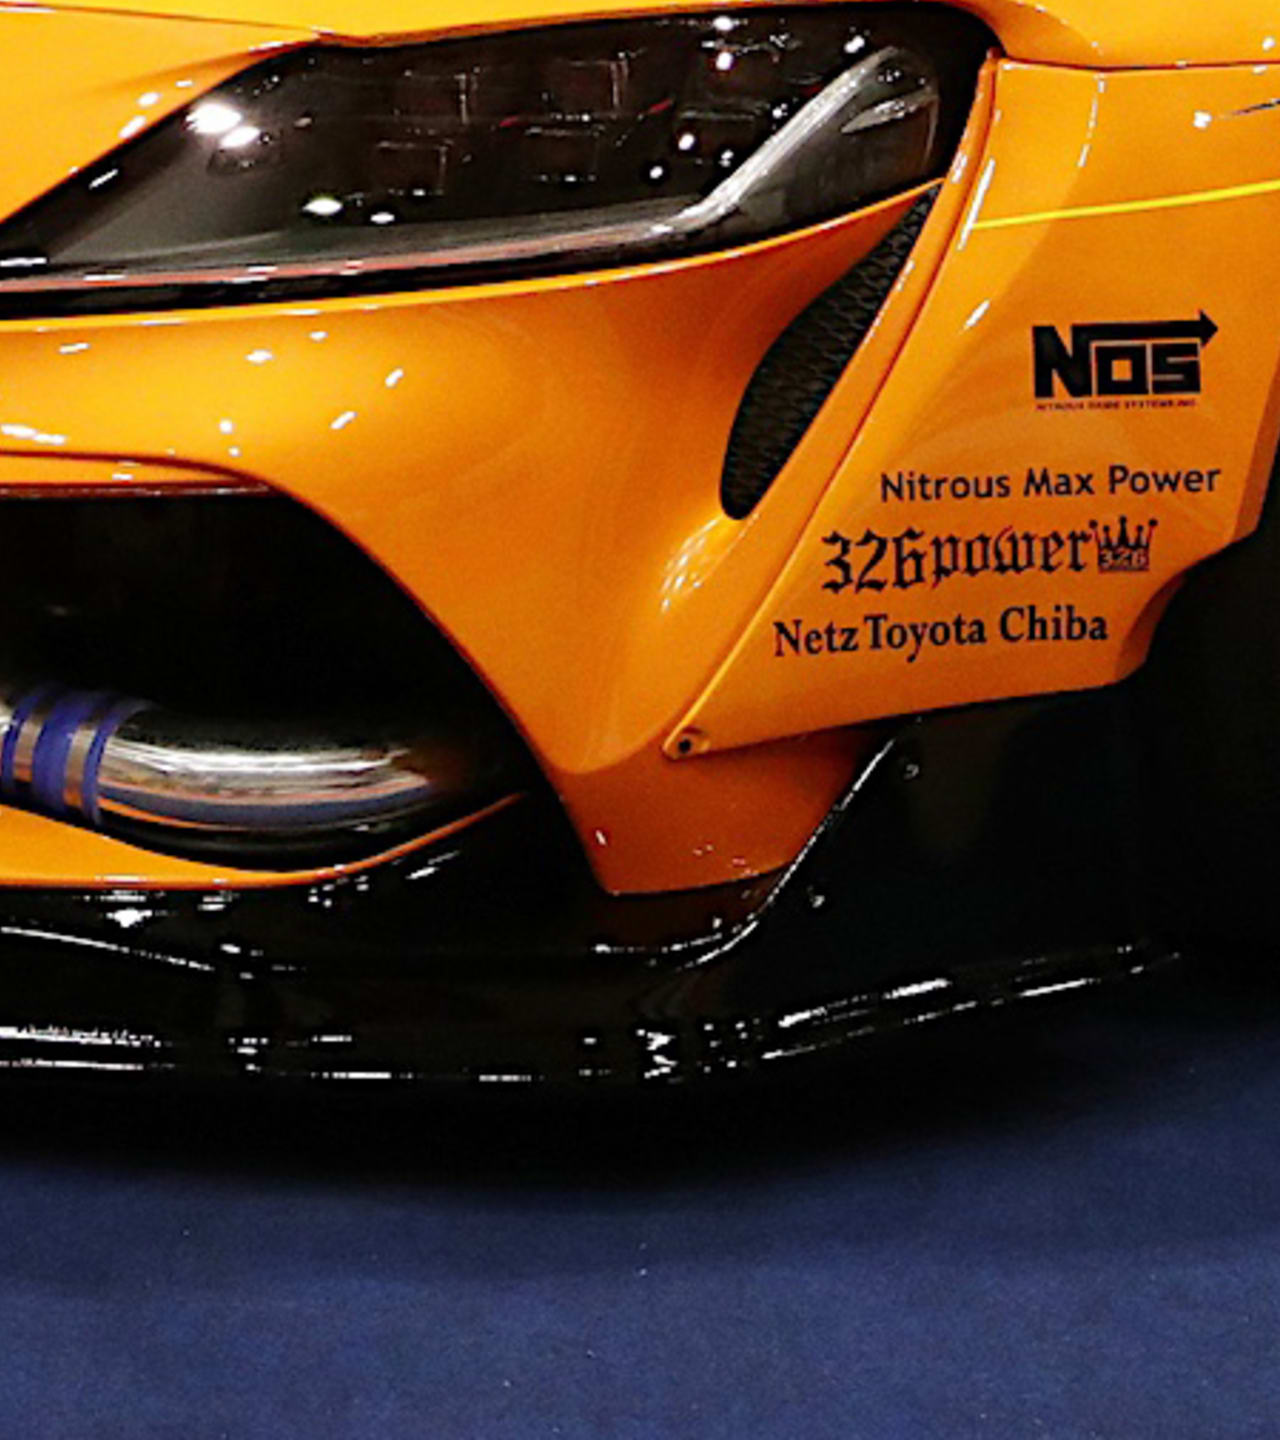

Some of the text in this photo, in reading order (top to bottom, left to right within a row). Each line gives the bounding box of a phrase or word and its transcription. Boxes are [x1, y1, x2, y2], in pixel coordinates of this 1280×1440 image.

[1031, 311, 1217, 400] NOS
[880, 463, 1222, 504] Nitrous Max Power
[773, 604, 1109, 664] Netz Toyota Chiba
